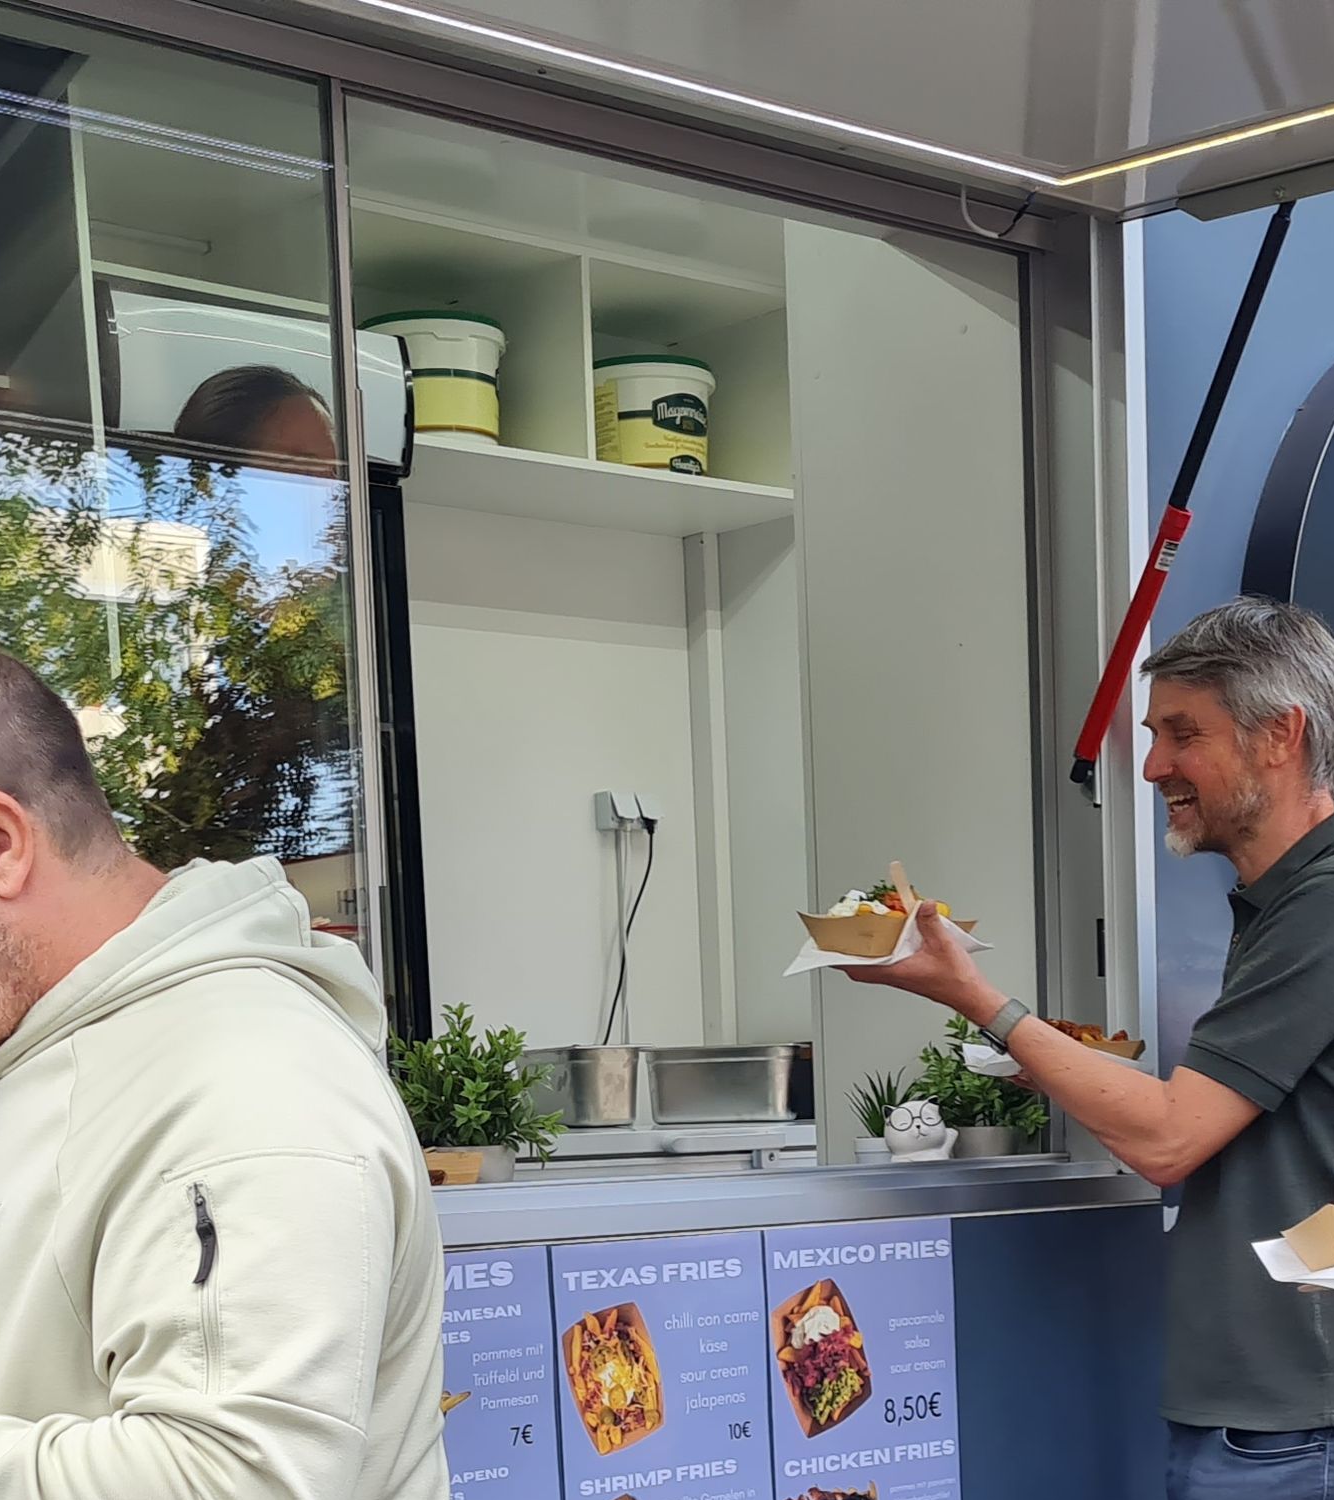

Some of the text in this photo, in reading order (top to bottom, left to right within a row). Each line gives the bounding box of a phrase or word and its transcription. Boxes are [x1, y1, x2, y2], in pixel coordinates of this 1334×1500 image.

[773, 1239, 951, 1270] MEXICO FRIES
[563, 1258, 743, 1291] TEXAS FRIES
[664, 1310, 760, 1330] chilli con carne
[699, 1338, 728, 1354] käse
[904, 1335, 930, 1350] salsa
[473, 1344, 544, 1366] pommes mit
[473, 1365, 545, 1387] Trüffelöl und
[680, 1364, 749, 1384] sour cream
[890, 1358, 947, 1375] sour cream
[481, 1394, 539, 1410] Parmesan
[685, 1391, 747, 1414] jalapenos
[884, 1391, 943, 1427] 8,50€
[510, 1424, 534, 1446] 7€
[728, 1421, 752, 1440] 10€
[783, 1439, 956, 1478] CHICKEN FRIES
[579, 1459, 738, 1496] SHRIMP FRIES
